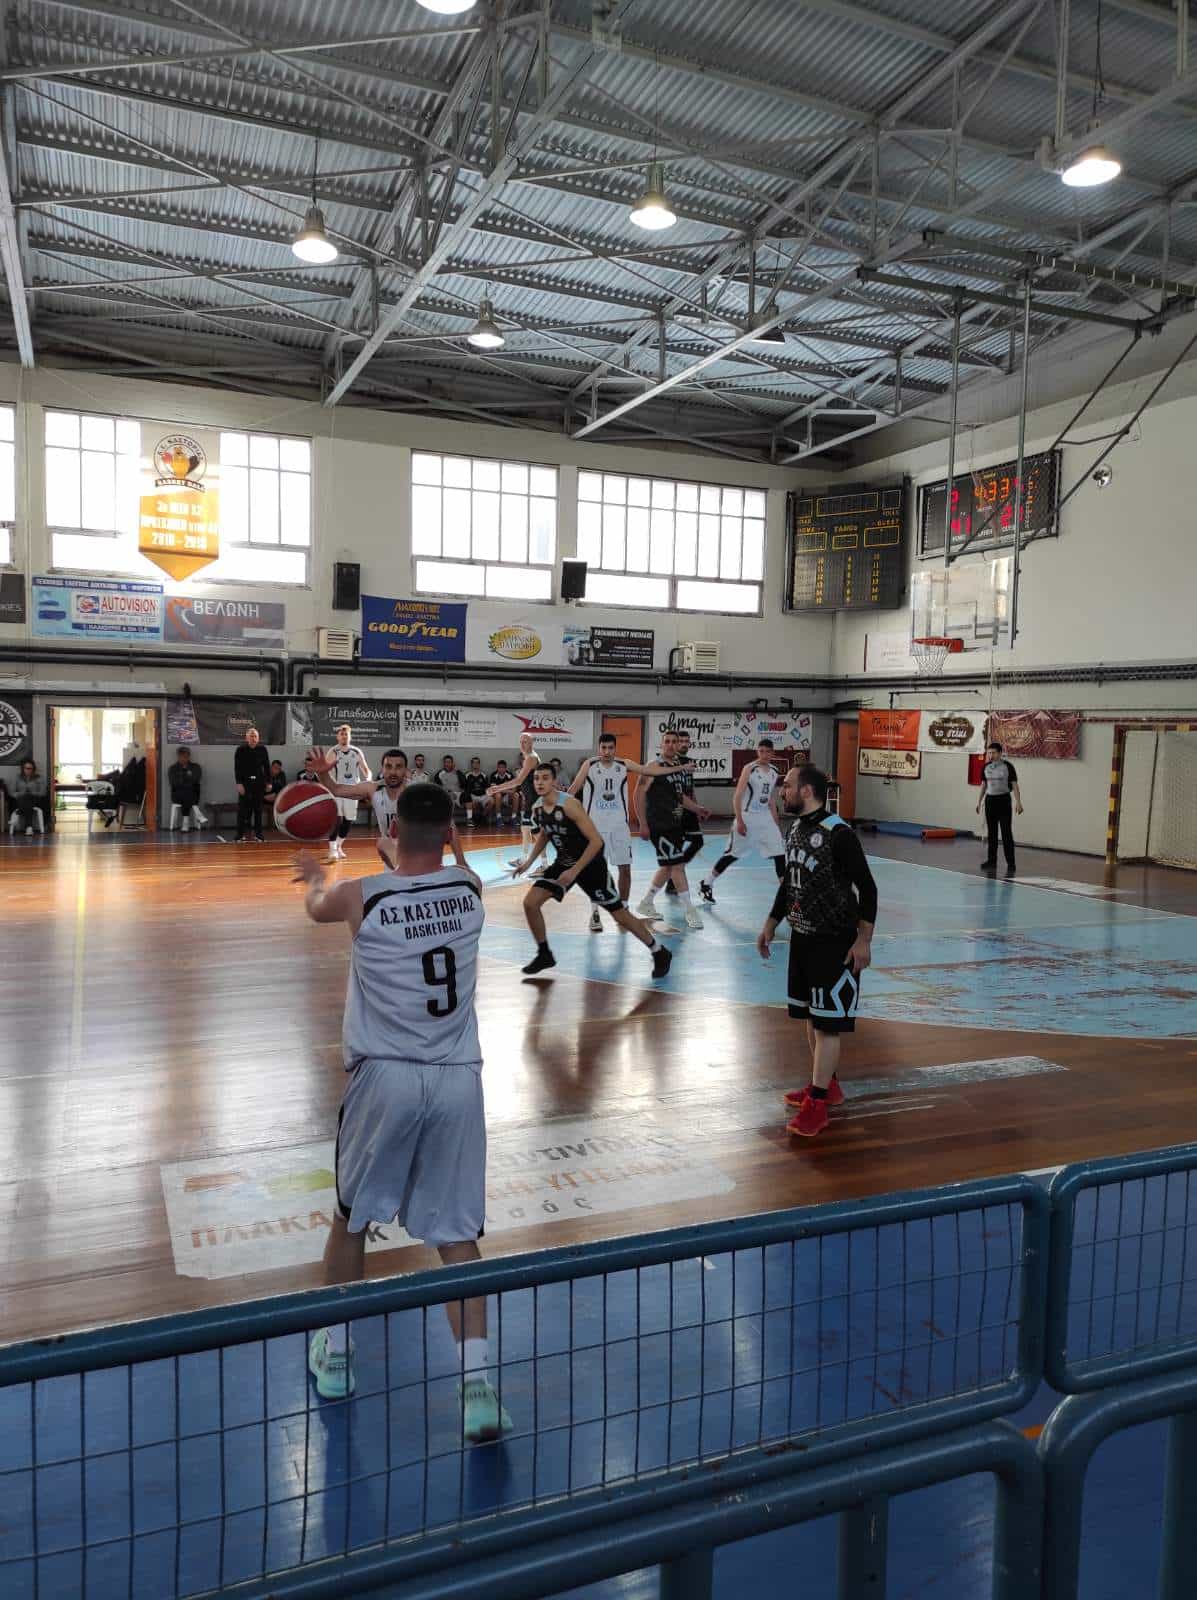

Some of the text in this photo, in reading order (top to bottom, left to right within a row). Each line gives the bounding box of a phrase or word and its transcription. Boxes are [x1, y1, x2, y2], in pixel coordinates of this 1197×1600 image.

[101, 597, 156, 612] AUTOVISION
[193, 600, 260, 617] ΒΕΛΩΝΗ
[404, 709, 460, 720] DAUWIN
[528, 713, 566, 729] ACS
[605, 778, 613, 790] 11
[404, 918, 463, 940] BASKETBALL
[421, 945, 458, 1018] 9
[811, 986, 825, 1008] 11
